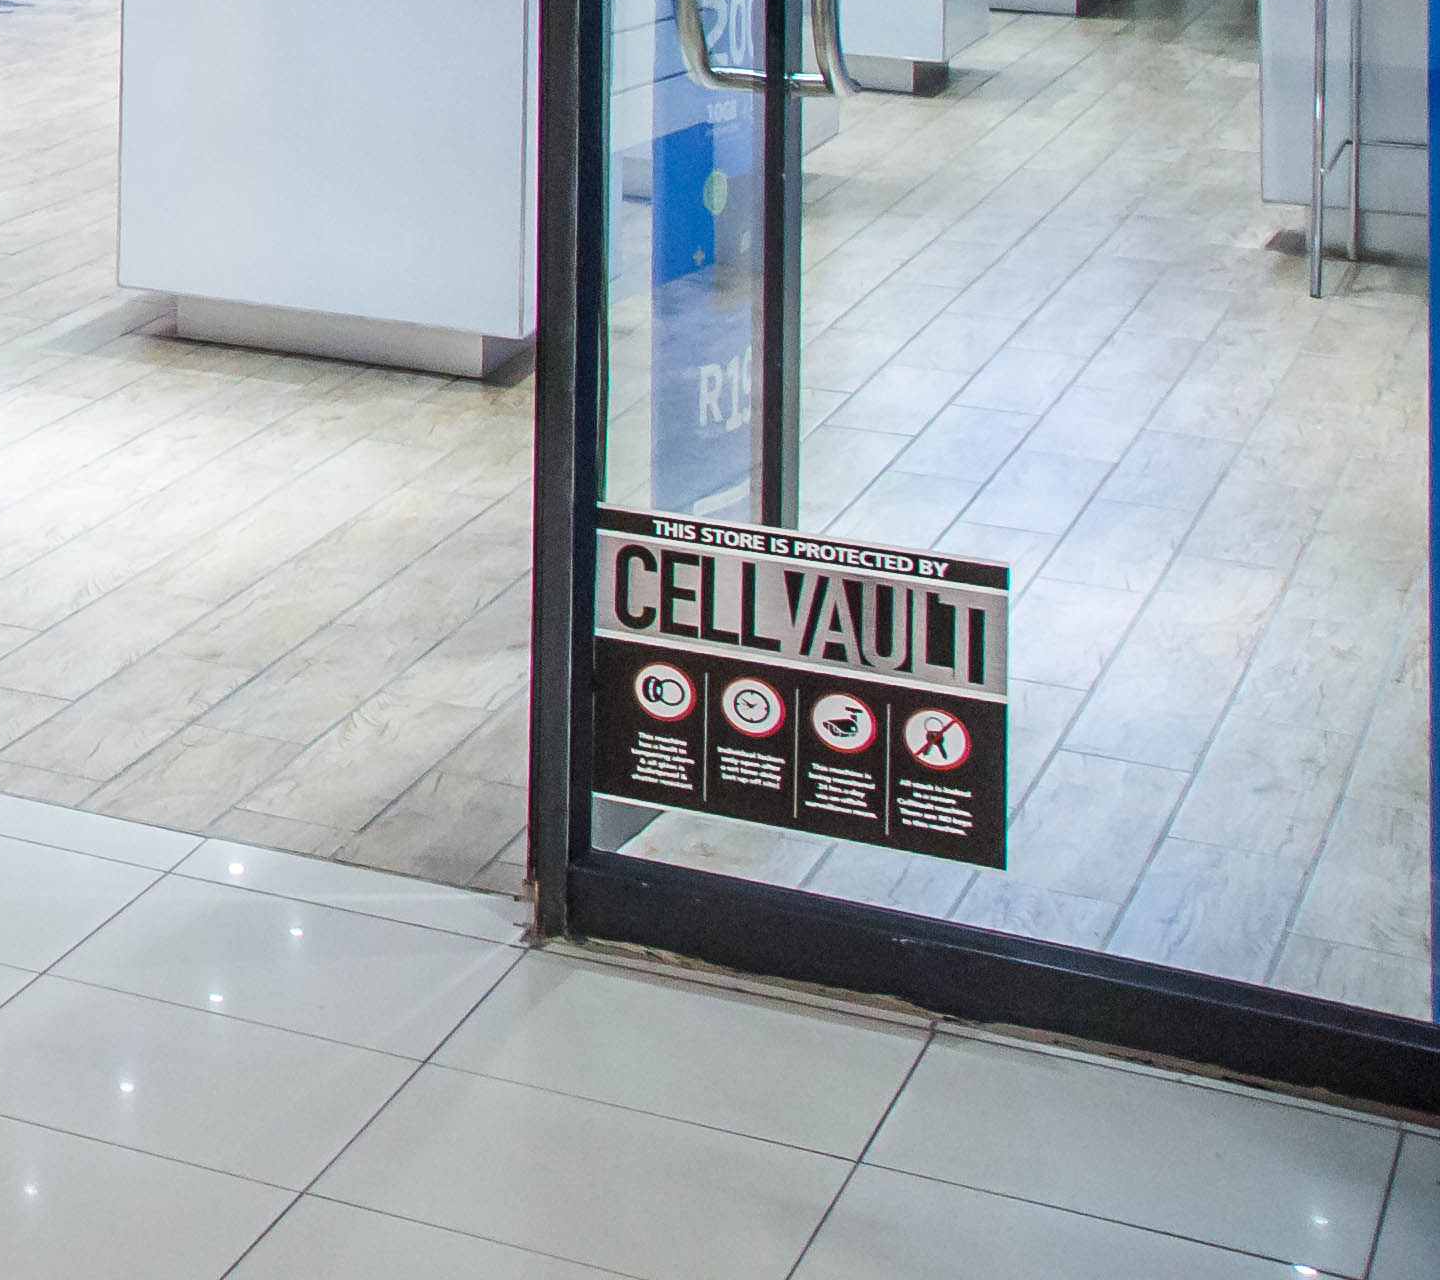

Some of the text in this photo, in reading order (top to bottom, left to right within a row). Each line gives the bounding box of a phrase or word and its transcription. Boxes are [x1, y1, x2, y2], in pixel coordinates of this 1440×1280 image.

[652, 519, 950, 578] THIS STORE IS PROTECTED BY
[614, 543, 987, 686] CELLVAULT
